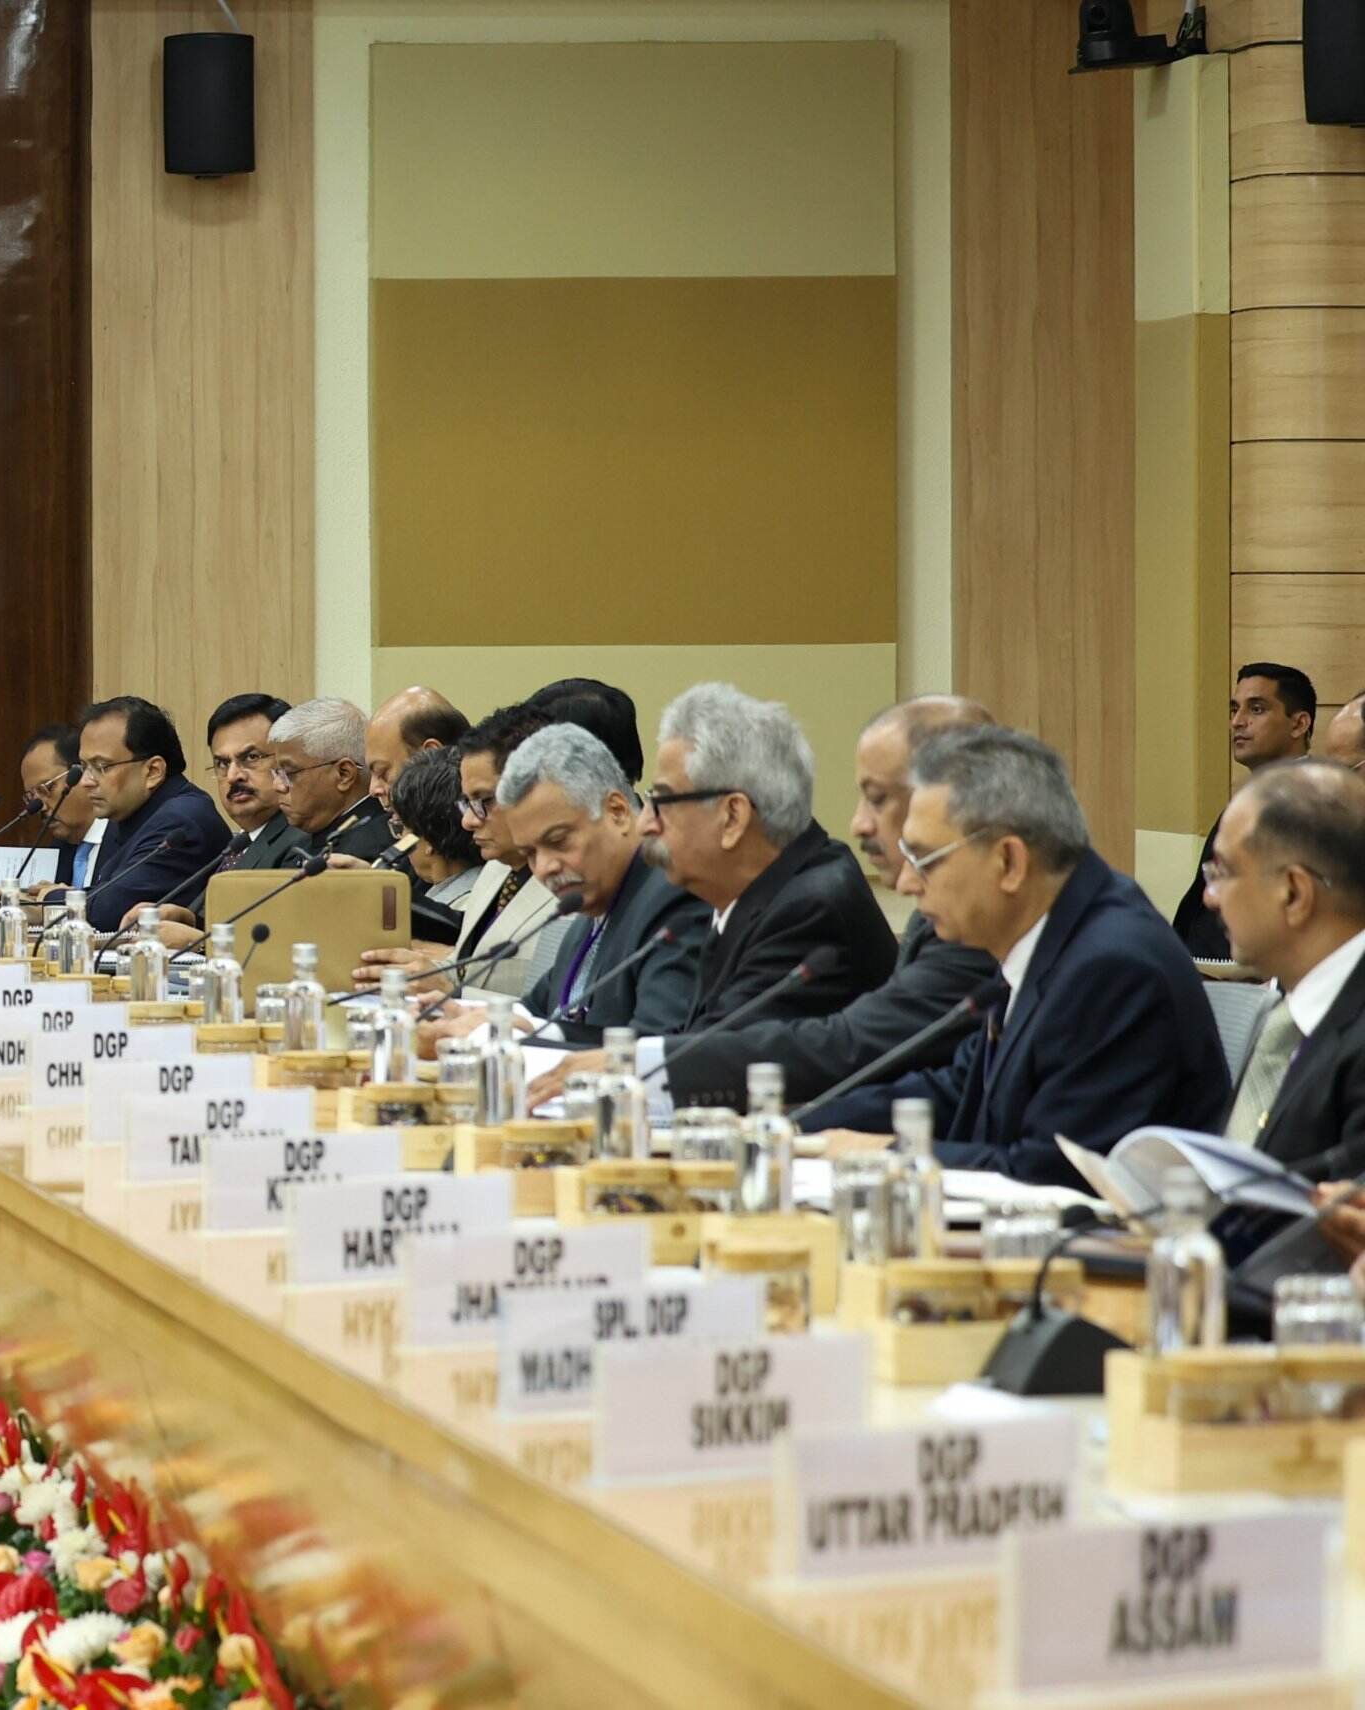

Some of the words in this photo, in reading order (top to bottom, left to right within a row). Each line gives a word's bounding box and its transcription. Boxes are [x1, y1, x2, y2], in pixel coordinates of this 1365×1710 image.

[2, 989, 33, 1007] DGP
[42, 1011, 74, 1032] DGP
[93, 1031, 128, 1059] DGP
[159, 1066, 194, 1093] DGP
[206, 1099, 245, 1130] DGP
[285, 1140, 325, 1172] DGP
[382, 1187, 427, 1222] DGP
[515, 1237, 563, 1276] DGP
[646, 1293, 690, 1336] DGP
[714, 1350, 771, 1397] DGP
[690, 1398, 789, 1449] SIKKIM
[916, 1431, 981, 1487] DGP
[806, 1496, 912, 1552] UTTAR
[1138, 1523, 1212, 1585] DGP
[1109, 1586, 1238, 1660] ASSAM
